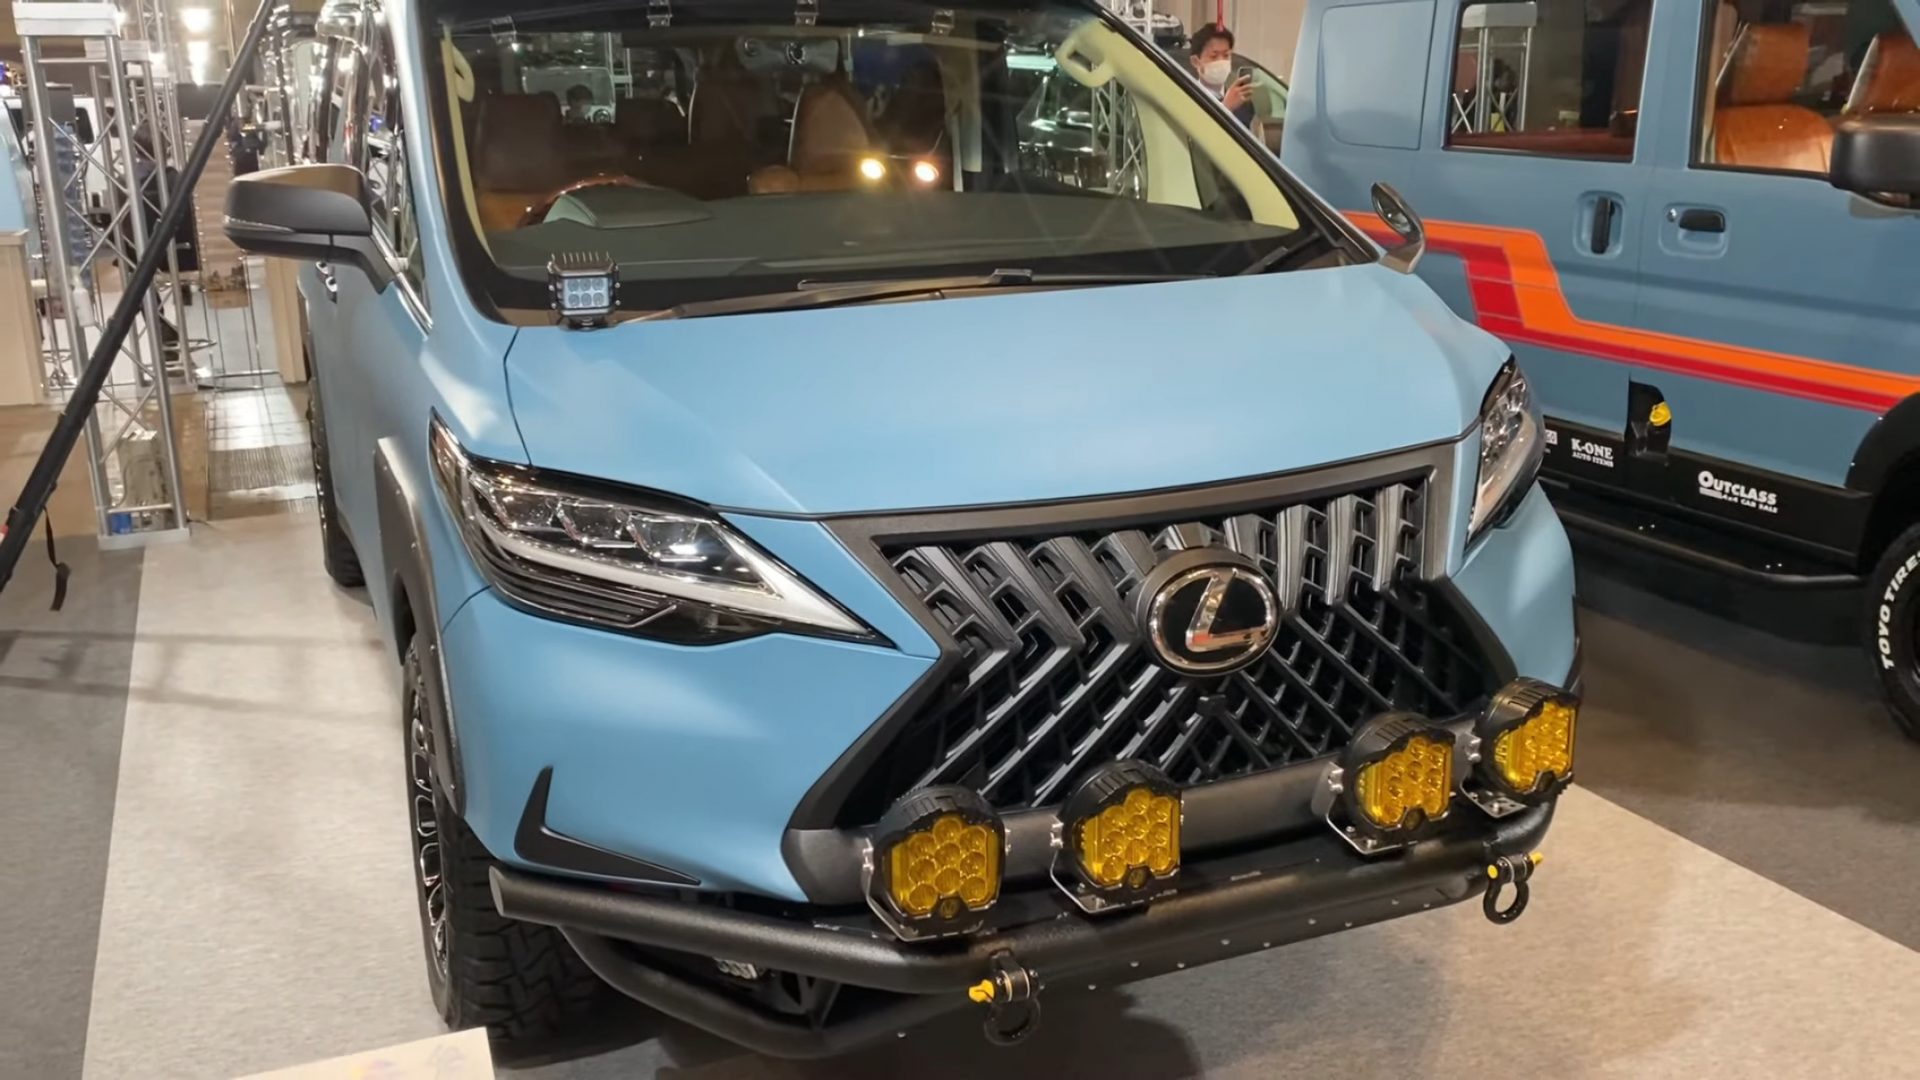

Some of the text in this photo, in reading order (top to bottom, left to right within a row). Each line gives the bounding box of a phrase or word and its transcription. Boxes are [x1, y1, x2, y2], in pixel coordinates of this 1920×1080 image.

[1571, 438, 1613, 460] K-ONE
[1572, 451, 1591, 462] AUTO
[1698, 470, 1777, 505] OUTCLASS
[1878, 604, 1894, 669] TOYO
